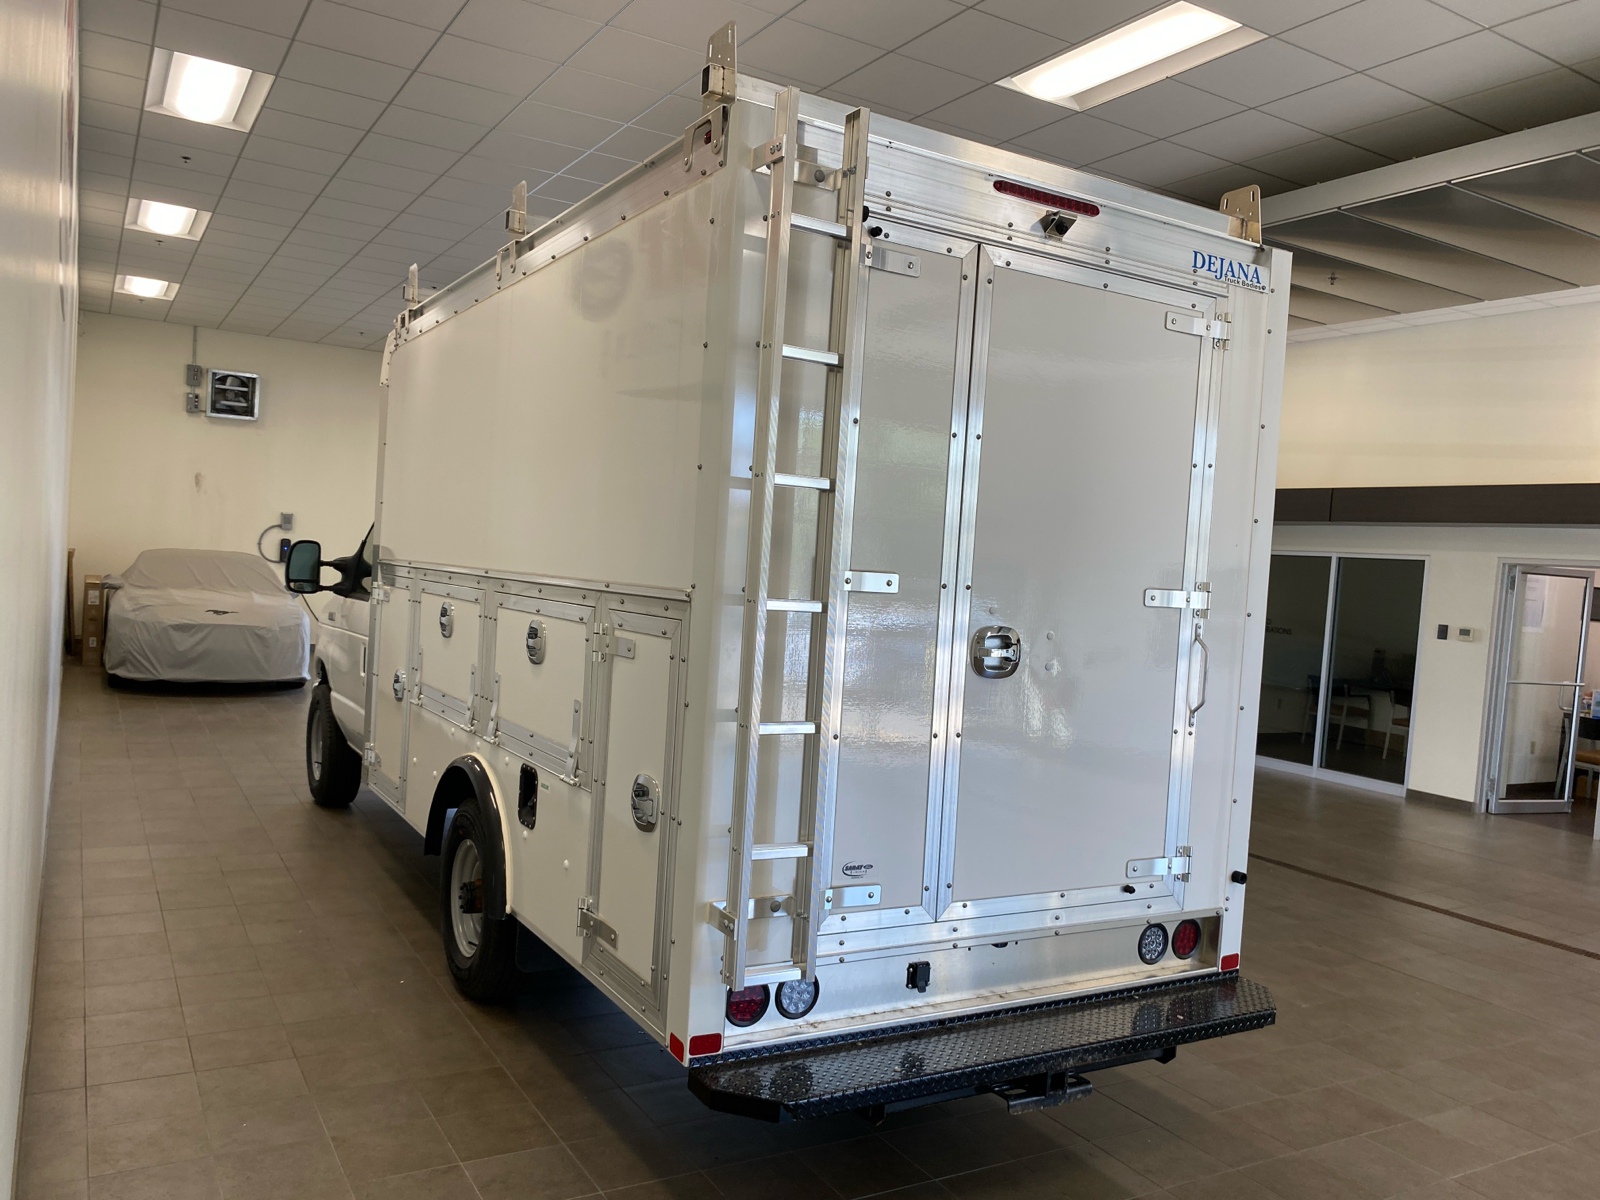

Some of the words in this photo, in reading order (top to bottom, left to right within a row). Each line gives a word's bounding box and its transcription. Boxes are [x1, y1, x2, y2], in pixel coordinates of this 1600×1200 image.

[1192, 250, 1261, 284] DEJANA
[1224, 275, 1240, 285] Truck
[1241, 280, 1262, 290] Bodies
